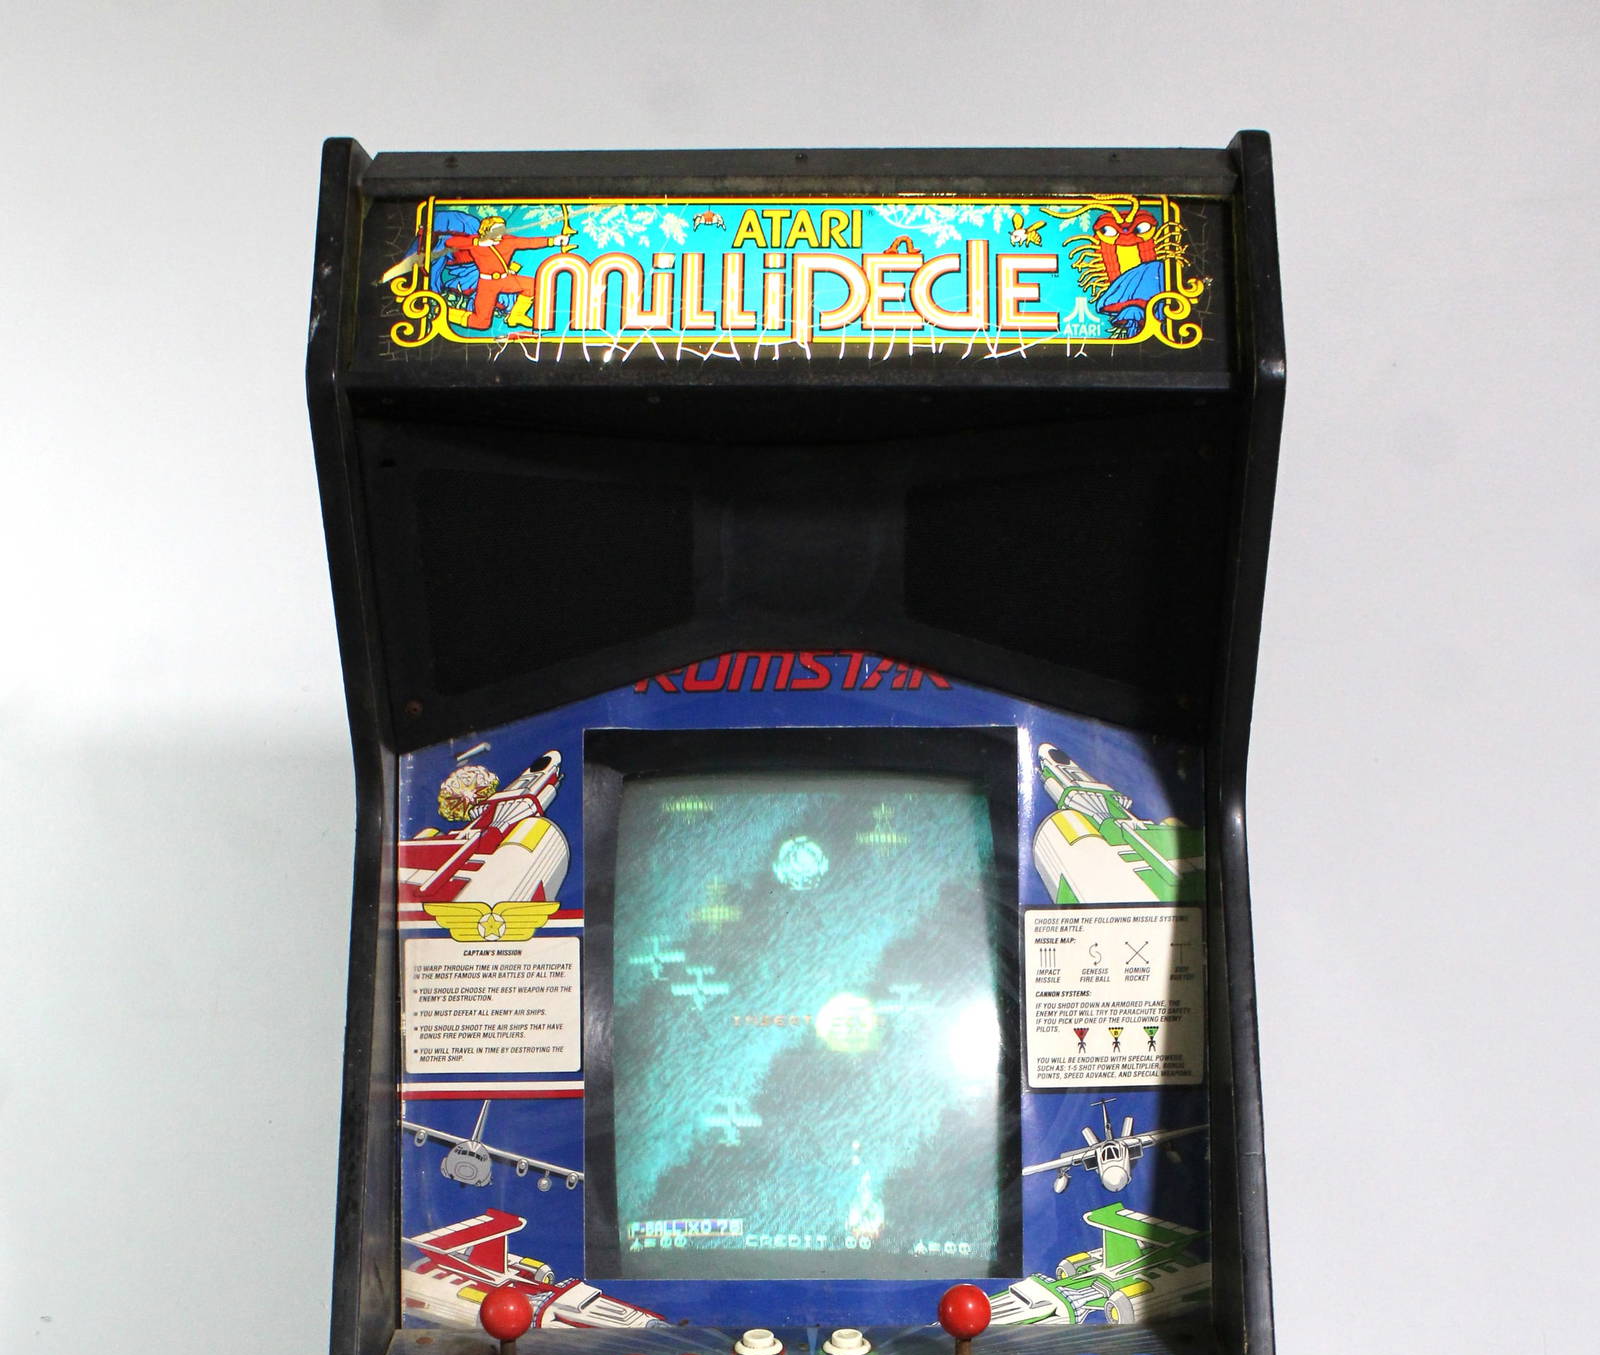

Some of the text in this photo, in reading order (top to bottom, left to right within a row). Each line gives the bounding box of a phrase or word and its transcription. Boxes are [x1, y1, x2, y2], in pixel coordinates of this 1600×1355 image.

[732, 209, 862, 248] ATARI
[1063, 323, 1102, 338] ATARI
[1034, 917, 1060, 925] CHOOSE
[444, 964, 474, 972] THROUGH
[536, 971, 547, 979] ALL
[1079, 1009, 1093, 1017] WILL
[1119, 1008, 1157, 1016] PARACHUTE
[434, 1024, 460, 1032] SHOULD
[420, 1032, 441, 1040] BONUS
[434, 1047, 449, 1055] WILL
[745, 1233, 828, 1249] CREDIT
